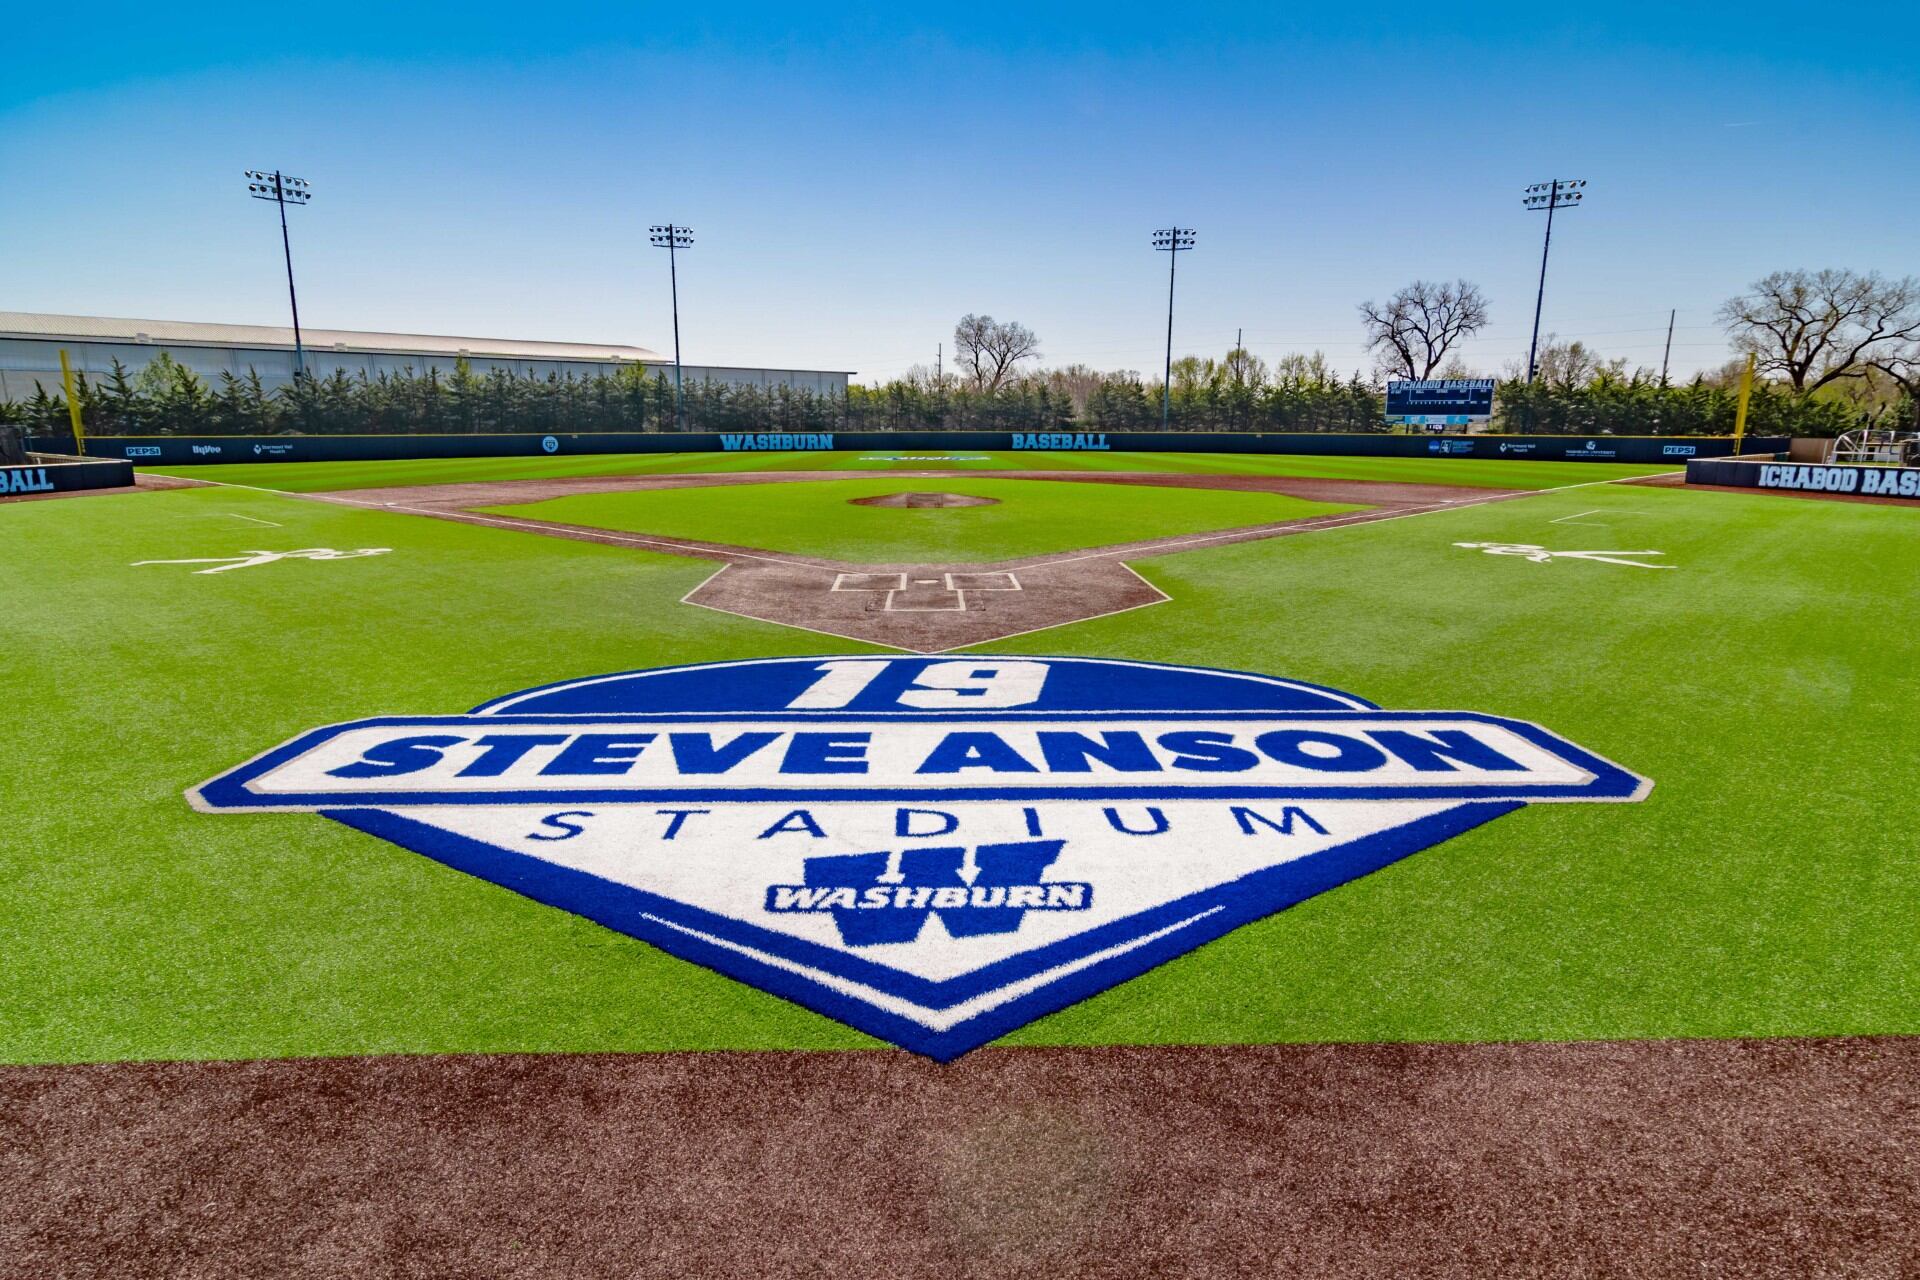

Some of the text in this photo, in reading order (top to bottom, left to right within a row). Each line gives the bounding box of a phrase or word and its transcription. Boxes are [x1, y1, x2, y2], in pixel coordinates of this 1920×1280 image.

[1443, 379, 1493, 389] BASEBALL
[127, 447, 160, 455] PEPSI
[720, 434, 834, 450] WASHBURN
[1011, 433, 1110, 449] BASEBALL
[1664, 446, 1695, 454] PEPSI
[1758, 465, 1858, 491] ICHABOD
[784, 660, 1051, 709] 19
[325, 730, 1533, 778] STEVE ANSON
[527, 804, 1330, 841] STADIUM
[775, 885, 1087, 910] WASHBURN
